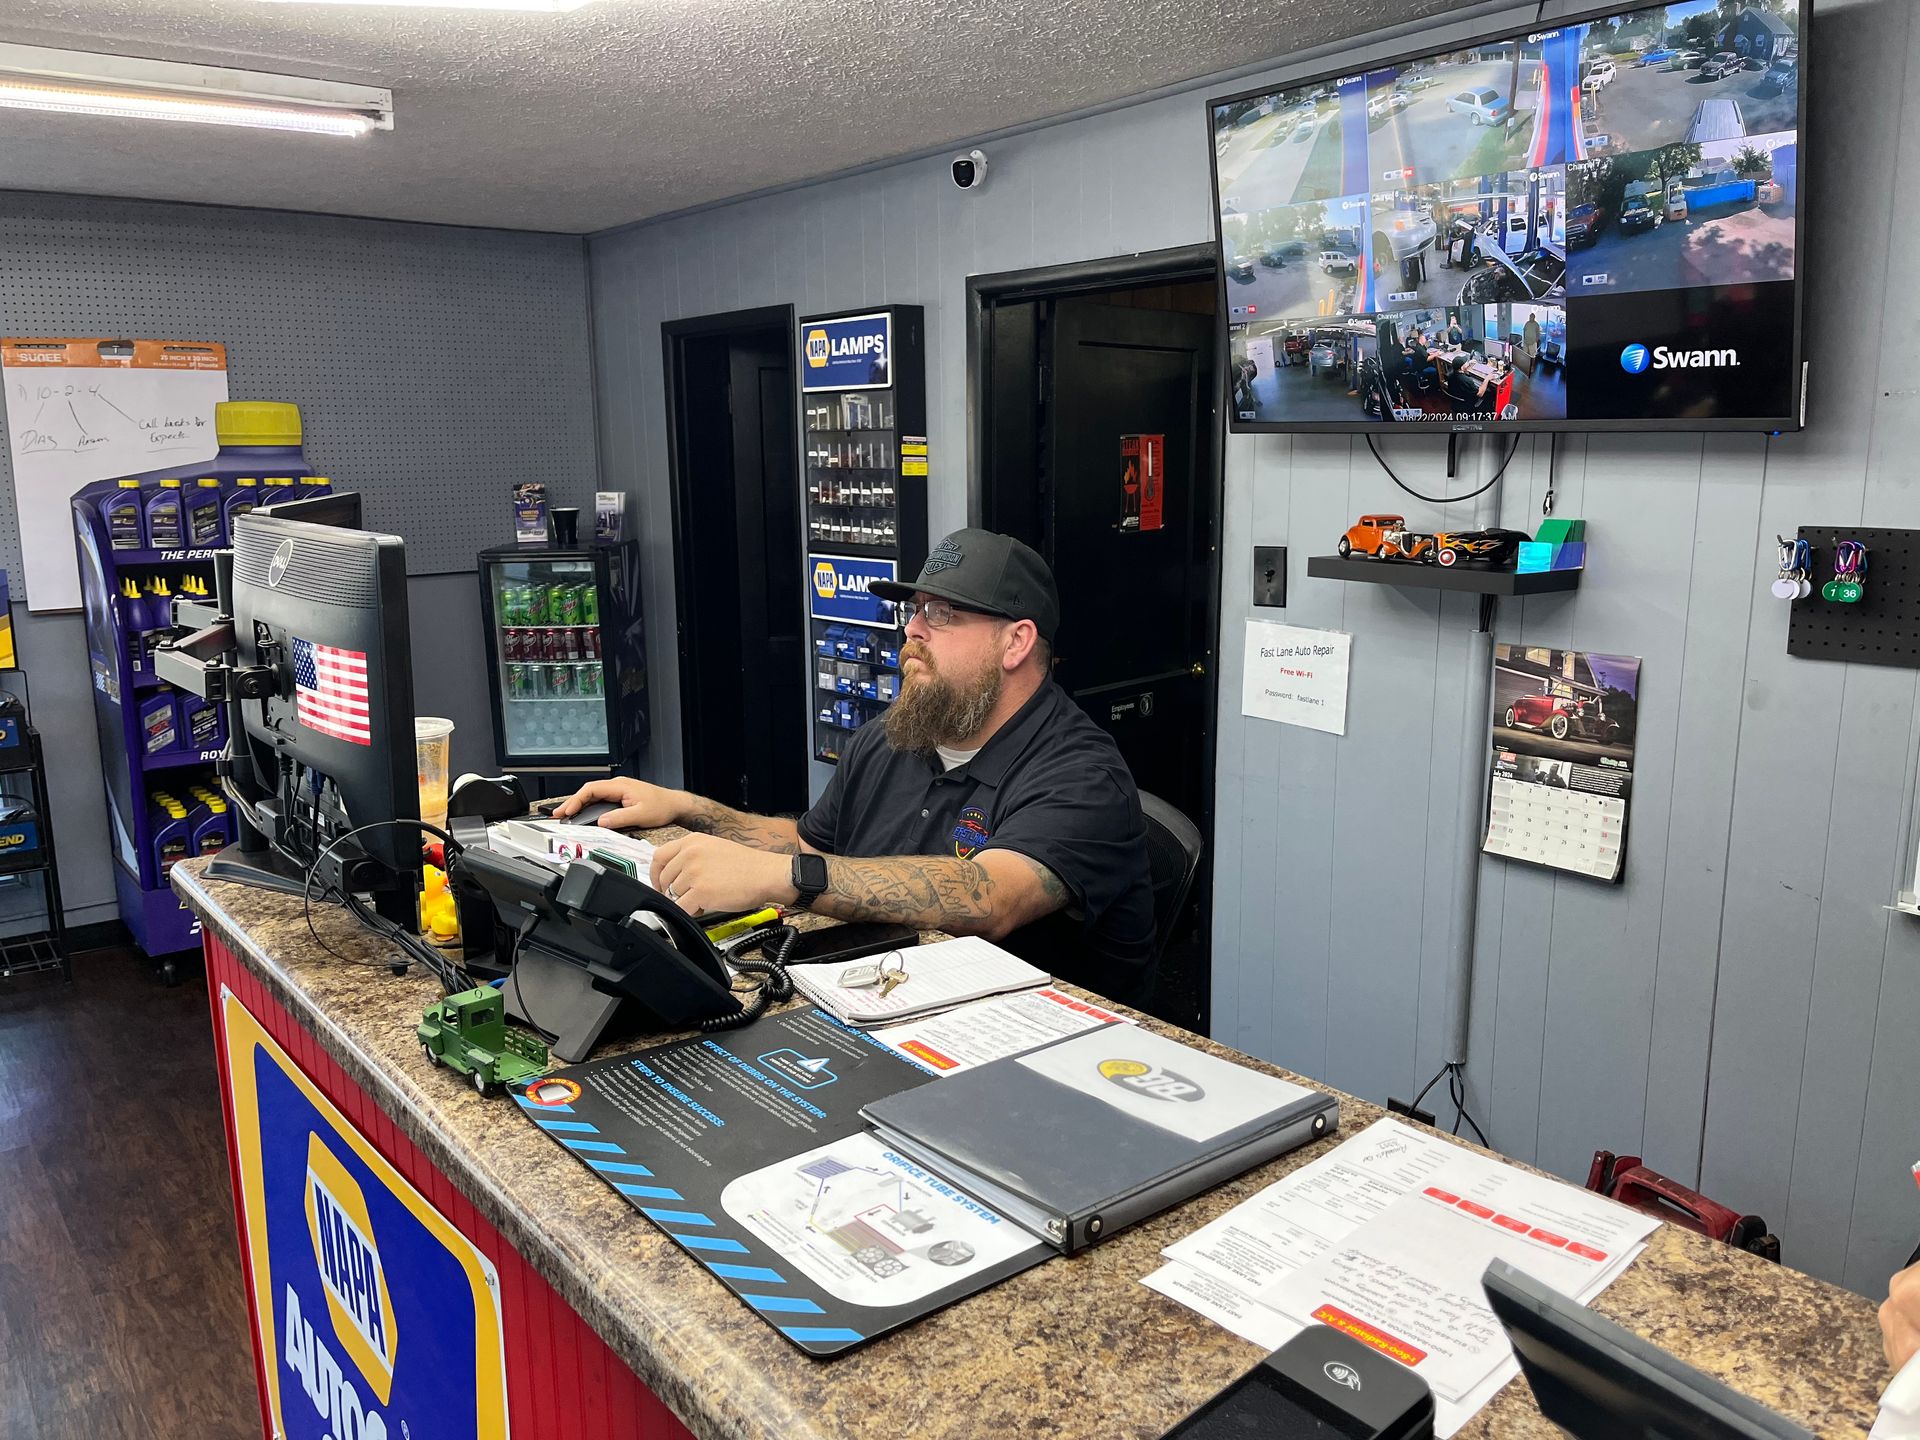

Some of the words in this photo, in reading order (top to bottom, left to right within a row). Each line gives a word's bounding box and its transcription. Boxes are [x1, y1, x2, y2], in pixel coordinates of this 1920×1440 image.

[1536, 30, 1560, 42] Swann
[1343, 75, 1362, 85] Swann
[1537, 171, 1560, 180] Swann
[1377, 313, 1399, 321] Channel
[809, 339, 827, 358] NAPA
[831, 334, 885, 357] LAMPS
[1456, 412, 1496, 421] 09:17:37
[160, 550, 185, 561] THE
[272, 554, 287, 569] DELL
[816, 570, 835, 589] NAPA
[1843, 589, 1857, 598] 36
[1260, 647, 1275, 658] Fast
[1276, 647, 1293, 657] Lane
[1294, 646, 1312, 656] Auto
[1312, 645, 1335, 657] Repair
[1279, 667, 1295, 676] Free
[1296, 669, 1313, 679] Wi-Fi
[1297, 694, 1320, 705] fastlane
[1111, 702, 1135, 713] Employees
[1111, 713, 1122, 721] Only
[1492, 770, 1501, 778] July
[631, 1060, 655, 1077] STEPS
[651, 1075, 665, 1084] TO
[660, 1082, 693, 1105] ENSURE
[702, 1040, 732, 1057] EFFECT
[728, 1056, 743, 1064] OF
[737, 1062, 767, 1081] DEBRIS
[764, 1079, 780, 1089] ON
[776, 1086, 796, 1099] THE
[791, 1094, 827, 1119] SYSTEM:
[882, 1151, 926, 1179] ORIFICE
[923, 1176, 956, 1197] TUBE
[952, 1195, 1001, 1225] SYSTEM
[314, 1183, 389, 1360] NAPA
[1317, 1310, 1337, 1324] A/C
[1350, 1324, 1417, 1363] 1-800-Radiator
